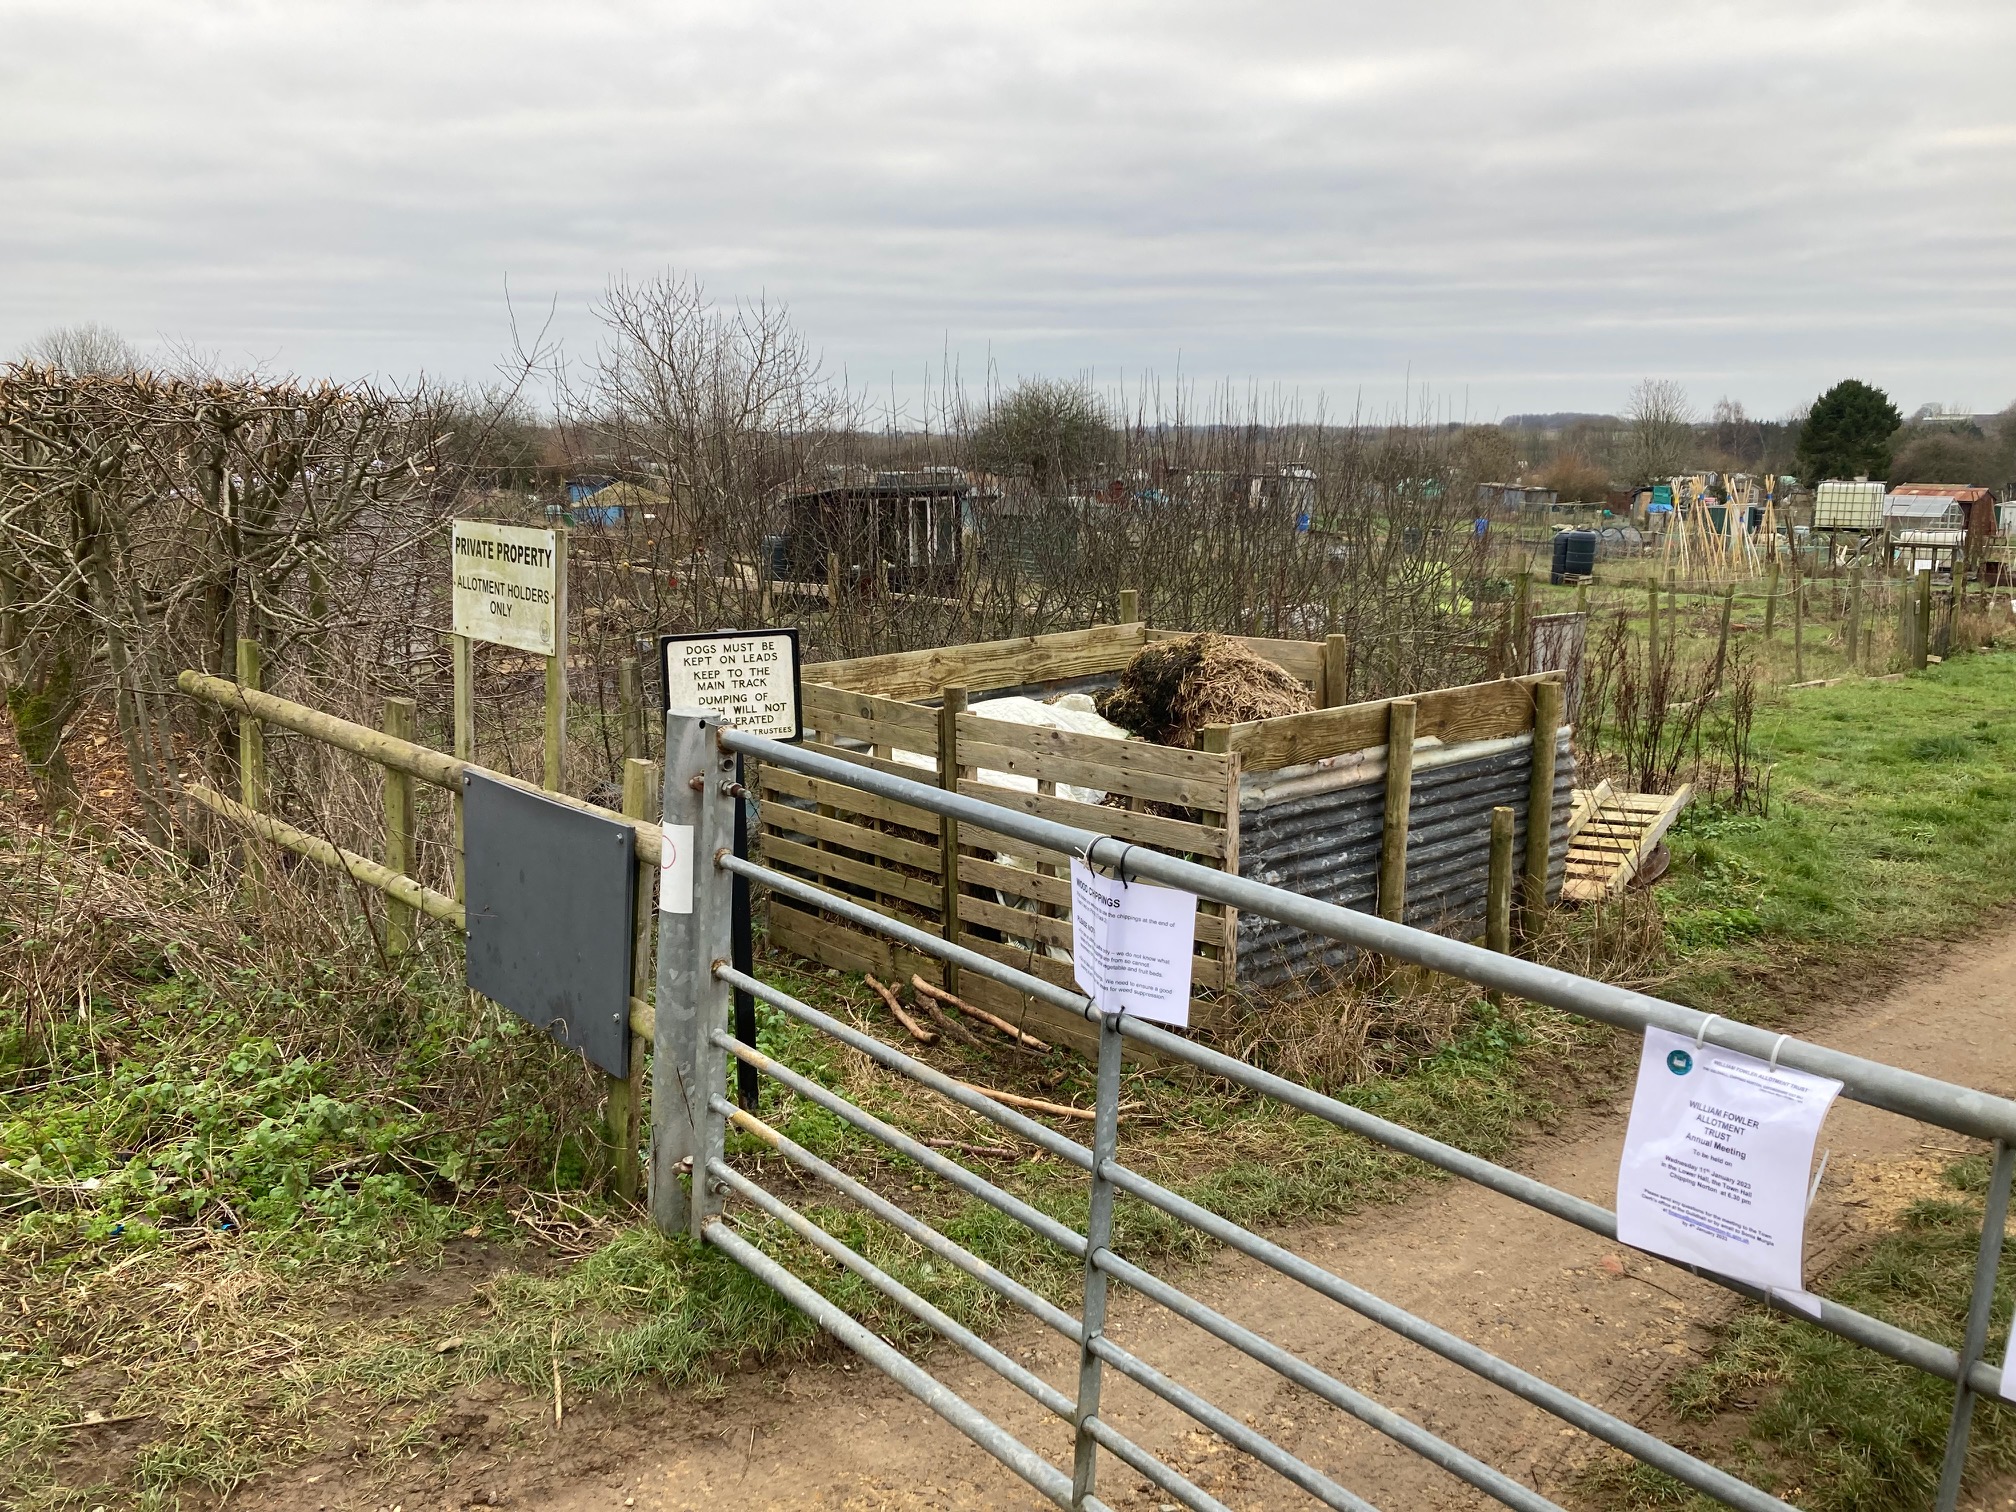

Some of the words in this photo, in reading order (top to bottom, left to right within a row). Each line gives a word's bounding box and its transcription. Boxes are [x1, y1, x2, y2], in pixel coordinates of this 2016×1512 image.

[455, 536, 494, 560] PRIVATE
[496, 542, 552, 568] PROPERTY
[456, 574, 506, 597] ALLOTMENT
[507, 584, 550, 604] HOLDERS
[490, 600, 512, 618] ONLY
[686, 645, 716, 655] DOGS
[723, 642, 754, 652] MUST
[762, 642, 774, 650] BE
[684, 656, 712, 666] KEPT
[720, 655, 736, 664] ON
[743, 652, 778, 663] LEADS
[694, 670, 720, 680] KEEP
[727, 668, 742, 678] TO
[749, 666, 770, 676] THE
[697, 681, 725, 691] MAIN
[732, 678, 767, 688] TRACK
[698, 694, 748, 705] DUMPING
[754, 692, 768, 701] OF
[733, 705, 757, 714] WILL
[764, 703, 787, 712] NOT
[753, 726, 792, 736] TRUSTEES
[1089, 887, 1120, 908] CHIPPINGS
[1117, 913, 1141, 922] chippings
[1136, 983, 1153, 991] ensure
[1758, 1074, 1790, 1087] ALLOTMENT
[1791, 1083, 1808, 1092] TRUST
[1689, 1100, 1722, 1118] WILLIAM
[1723, 1111, 1759, 1129] FOWLER
[1696, 1114, 1745, 1136] ALLOTMENT
[1704, 1127, 1731, 1142] TRUST
[1686, 1133, 1712, 1147] Annual
[1714, 1142, 1747, 1161] Meeting
[1710, 1155, 1723, 1164] held
[1665, 1155, 1698, 1171] Wednesday
[1711, 1171, 1735, 1185] January
[1670, 1172, 1696, 1186] Chipping
[1697, 1182, 1717, 1193] Norton
[1678, 1168, 1696, 1177] Lower
[1723, 1182, 1739, 1193] Town
[1740, 1189, 1752, 1198] Hall
